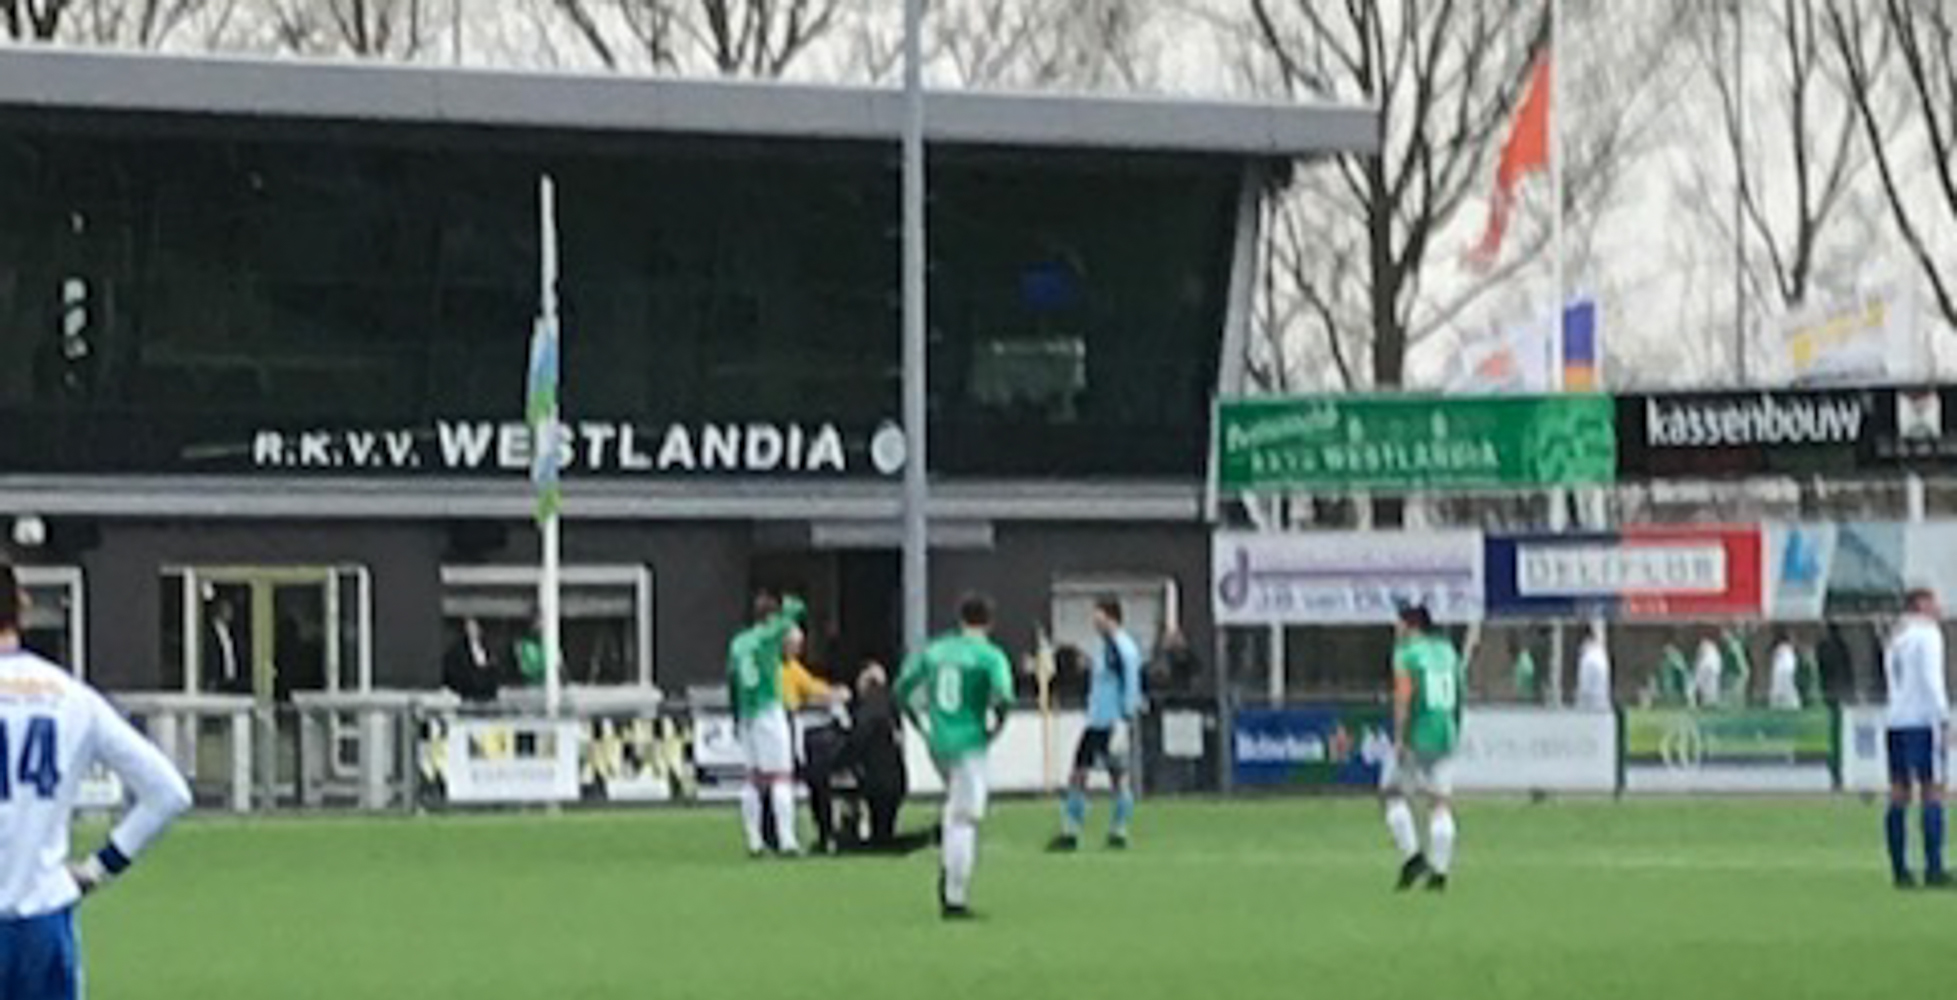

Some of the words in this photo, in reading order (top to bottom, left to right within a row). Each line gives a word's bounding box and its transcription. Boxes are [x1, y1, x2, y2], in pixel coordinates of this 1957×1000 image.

[254, 431, 420, 467] R.K.V.V.
[437, 419, 846, 471] WESTLANDIA
[1645, 394, 1861, 446] kassenbouw
[0, 716, 60, 800] 14
